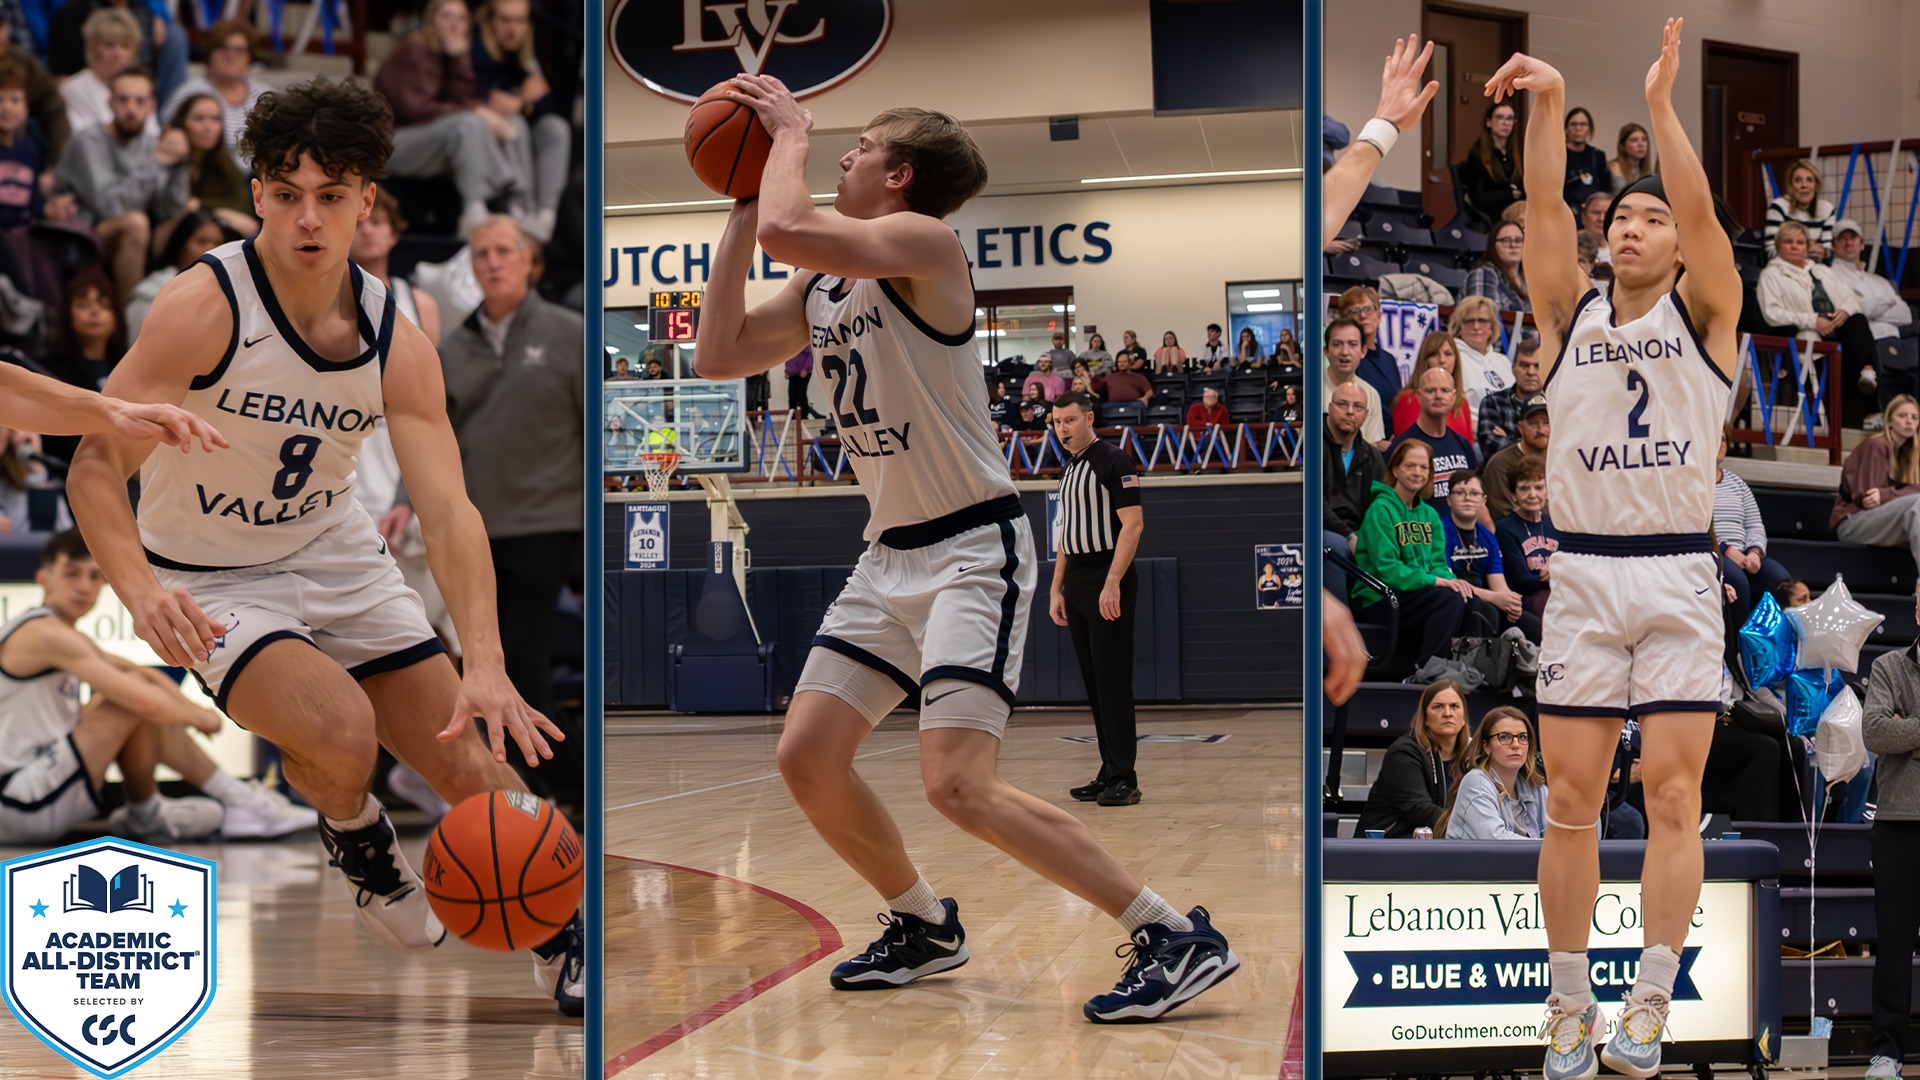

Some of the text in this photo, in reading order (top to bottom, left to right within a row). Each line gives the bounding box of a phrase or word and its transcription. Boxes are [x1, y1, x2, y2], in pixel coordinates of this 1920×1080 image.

[668, 311, 693, 339] 15
[1575, 337, 1682, 367] LEBANON
[822, 348, 880, 428] 22
[1627, 369, 1651, 438] 2
[838, 421, 910, 458] ALLEY
[1577, 441, 1691, 472] VALLEY
[272, 434, 322, 500] 8
[196, 484, 351, 526] VALLEY
[639, 538, 655, 549] 10
[1344, 892, 1486, 938] Lebanon
[1391, 960, 1641, 990] BLUE & WHI CLU
